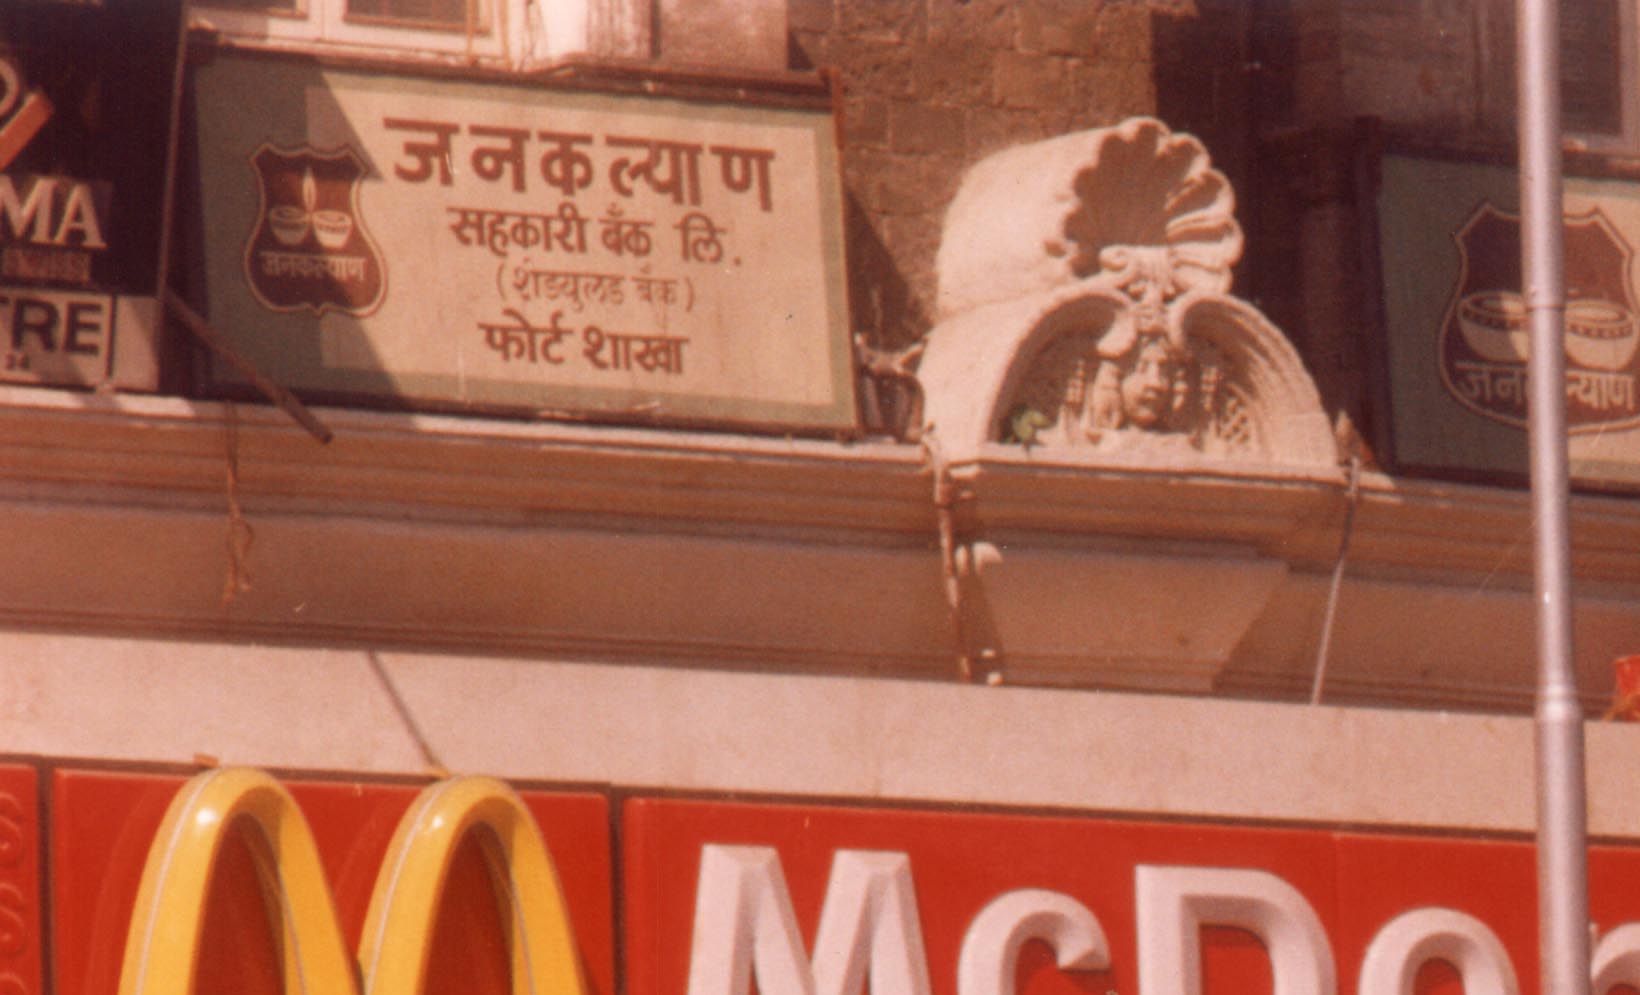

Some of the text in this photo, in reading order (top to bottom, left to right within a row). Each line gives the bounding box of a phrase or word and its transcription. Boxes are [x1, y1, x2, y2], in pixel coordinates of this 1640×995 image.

[384, 118, 775, 212] जनकल्याण
[446, 202, 589, 256] सहकारी
[673, 212, 742, 266] लि.
[477, 308, 690, 374] फोर्ट शाखा
